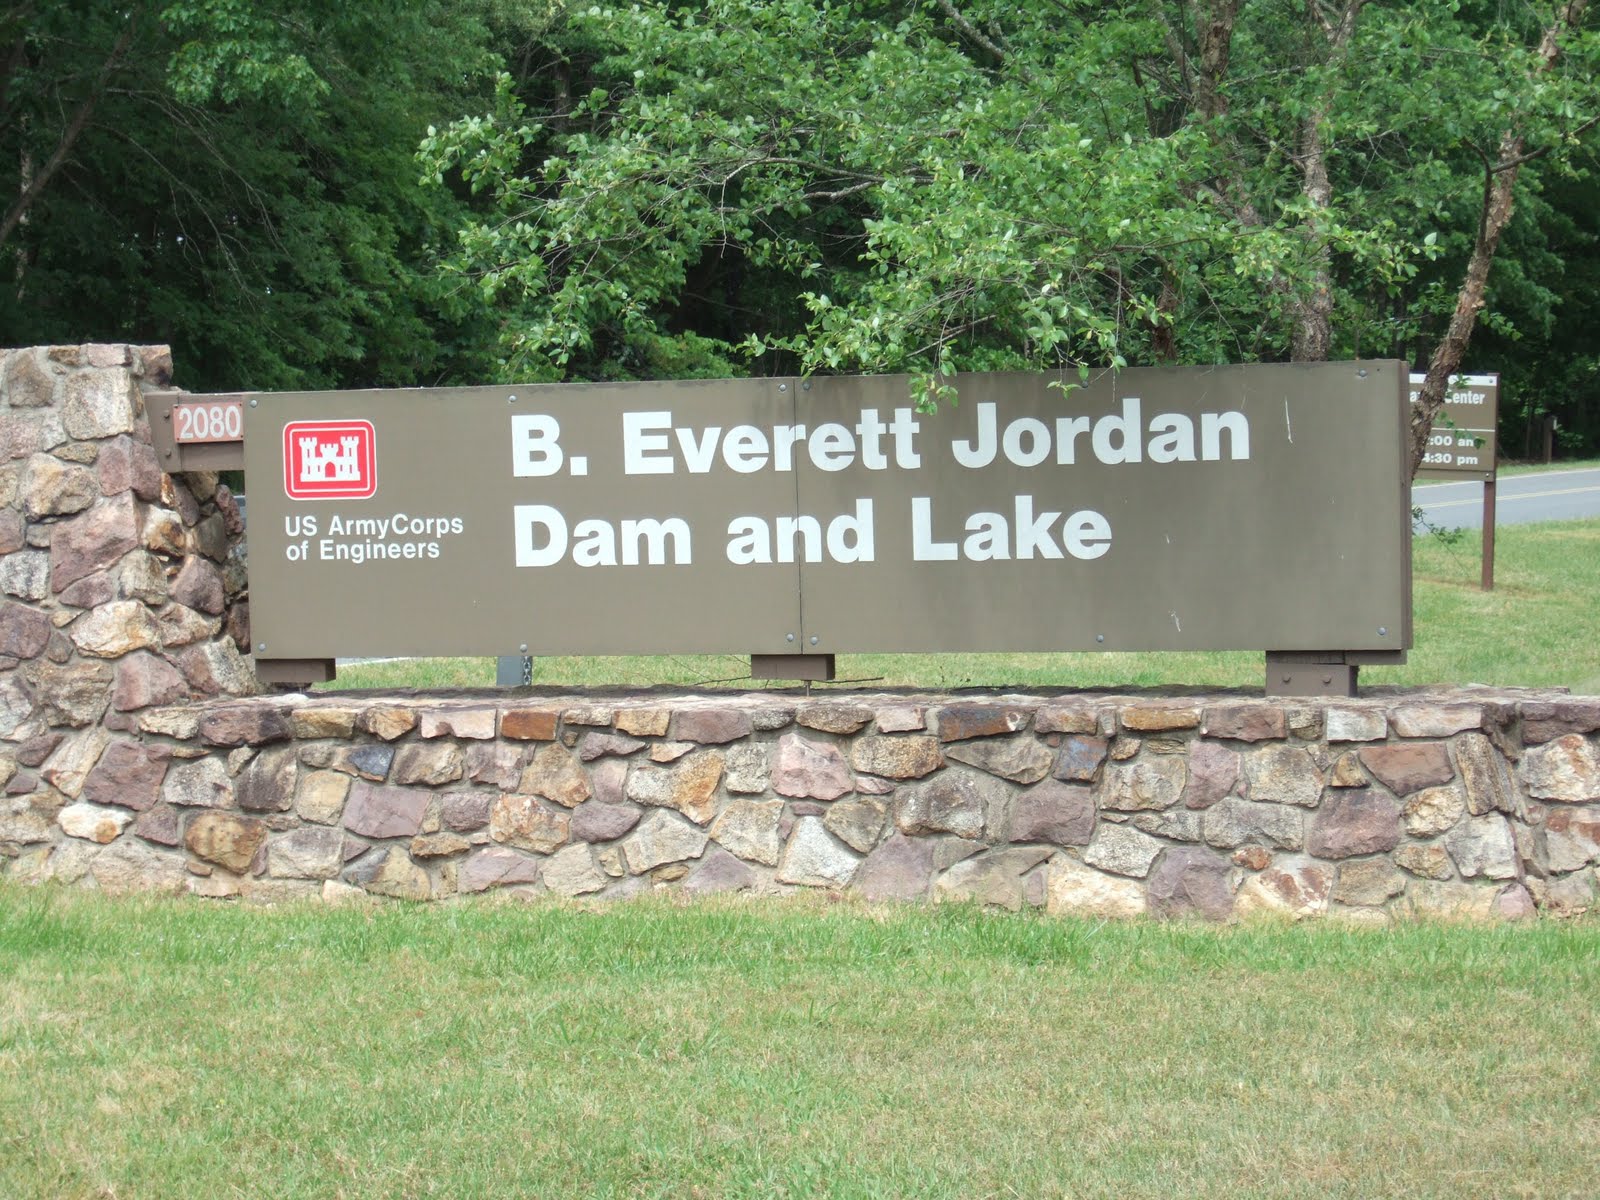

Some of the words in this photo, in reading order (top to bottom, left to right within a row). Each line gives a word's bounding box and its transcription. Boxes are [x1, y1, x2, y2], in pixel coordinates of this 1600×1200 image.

[178, 405, 241, 439] 2080
[511, 414, 588, 478] B.
[622, 407, 921, 475] Everett
[951, 398, 1250, 469] Jordan
[1427, 435, 1453, 446] :00
[1457, 456, 1478, 466] pm
[285, 515, 318, 537] US
[513, 504, 692, 568] Dam
[725, 498, 875, 565] and
[911, 494, 1113, 562] Lake
[285, 539, 309, 561] of
[319, 535, 440, 564] Engineers
